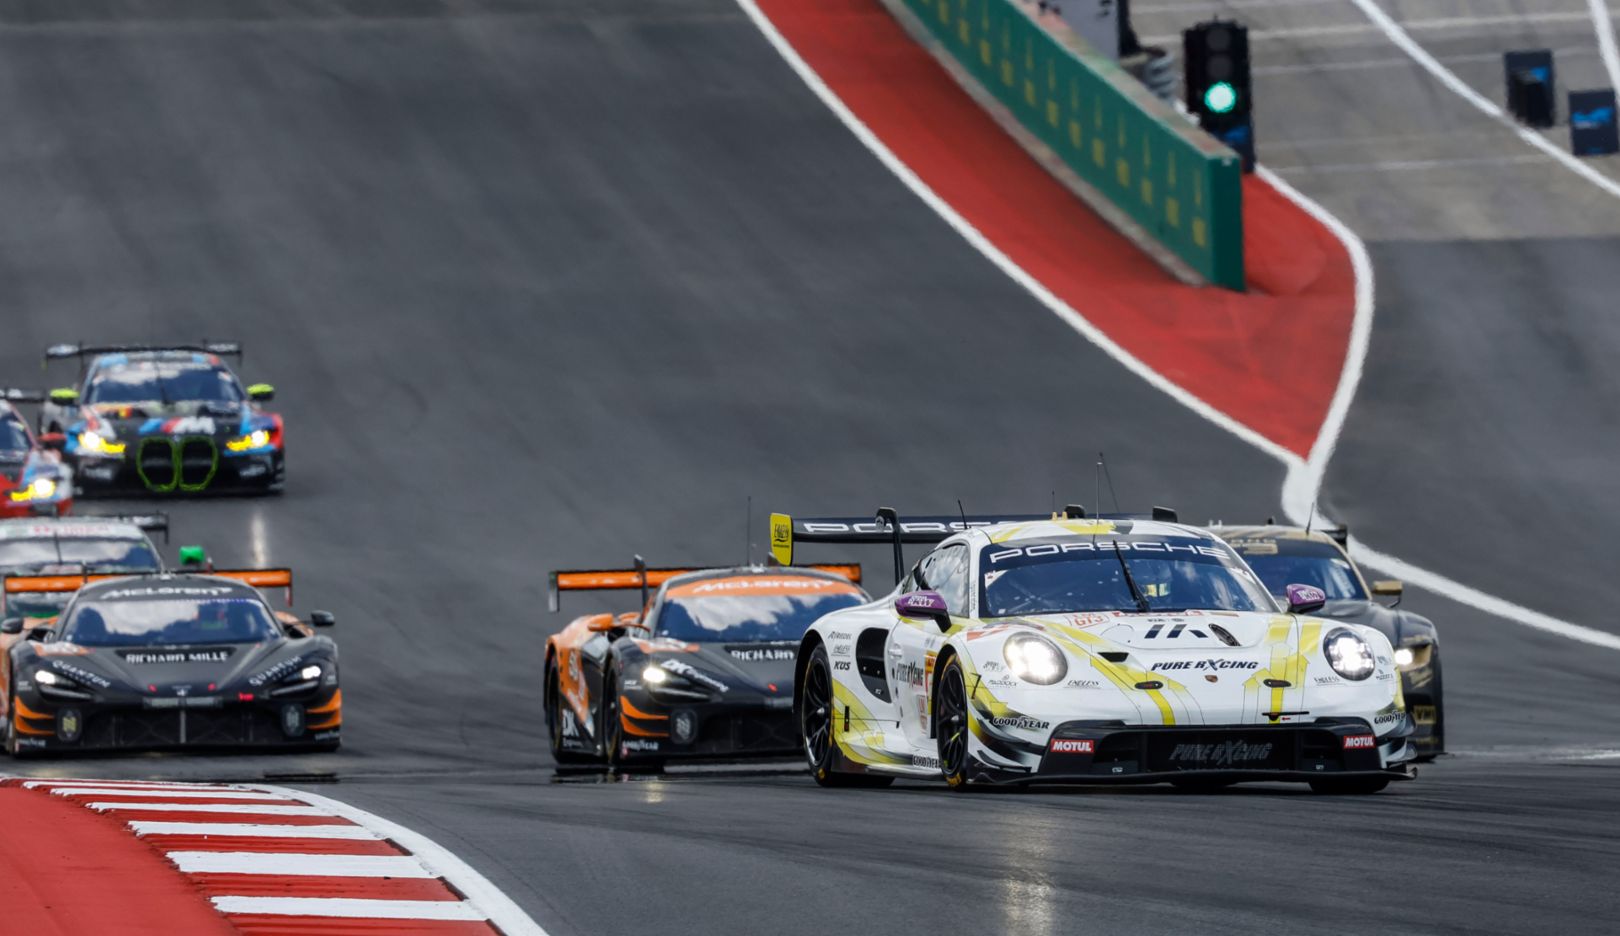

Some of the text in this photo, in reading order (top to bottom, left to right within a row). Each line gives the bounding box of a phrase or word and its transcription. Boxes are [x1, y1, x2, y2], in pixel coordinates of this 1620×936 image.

[804, 521, 1016, 533] PORS
[990, 542, 1230, 564] PORSCHE
[126, 652, 228, 663] RICHARD MILLE
[731, 649, 795, 661] RICHARD
[249, 656, 302, 686] QUANTUM
[834, 660, 851, 670] KUS
[1151, 659, 1259, 671] PURE RXCING
[52, 660, 111, 688] QUANTUM
[993, 717, 1050, 730] GOODYEAR
[1053, 741, 1091, 752] MOTUL
[1345, 737, 1374, 747] MOTUL
